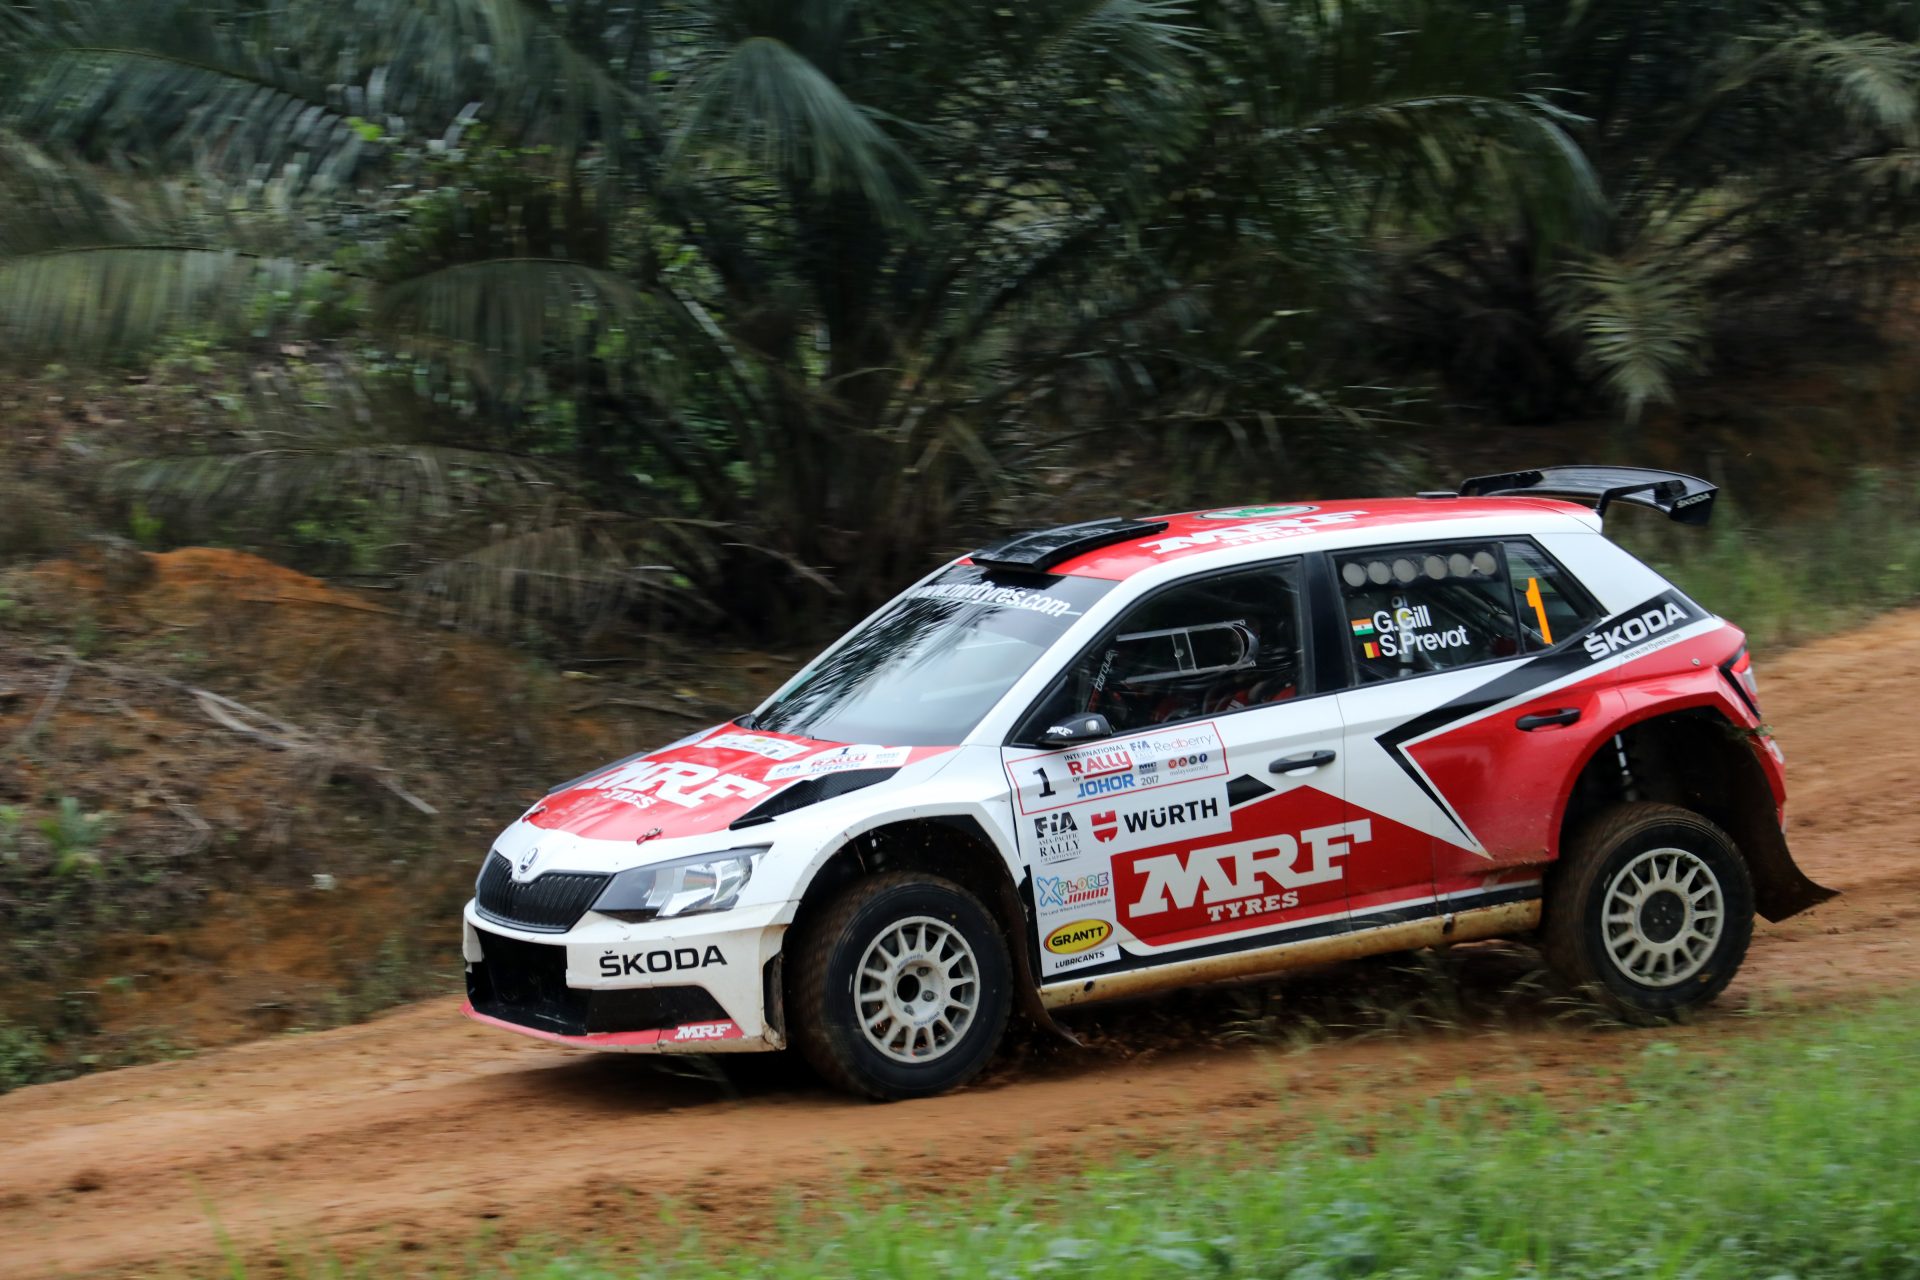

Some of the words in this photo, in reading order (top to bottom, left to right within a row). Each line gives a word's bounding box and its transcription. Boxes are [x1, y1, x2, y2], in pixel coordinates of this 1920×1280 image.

[1139, 511, 1370, 554] MRF
[1373, 605, 1431, 633] G.Gill
[1526, 577, 1552, 644] 1
[1379, 625, 1470, 657] S.Prevot
[1583, 602, 1688, 660] ŠKODA
[1064, 744, 1125, 760] INTERNATIONAL
[1153, 735, 1212, 752] Redberry
[1067, 751, 1132, 776] RALLY
[575, 761, 771, 808] MRF
[1033, 767, 1056, 797] 1
[1077, 773, 1135, 798] JOHOR
[1141, 775, 1159, 786] 2017
[1123, 798, 1218, 833] WÜRTH
[1040, 840, 1079, 857] RALLY
[1129, 819, 1372, 918] MRF
[1036, 872, 1109, 907] XPLORE
[1207, 891, 1299, 922] TYRES
[1052, 926, 1104, 947] GRANTT
[599, 945, 728, 977] ŠKODA
[1055, 951, 1105, 968] LUBRICANTS
[675, 1024, 732, 1040] MRF
